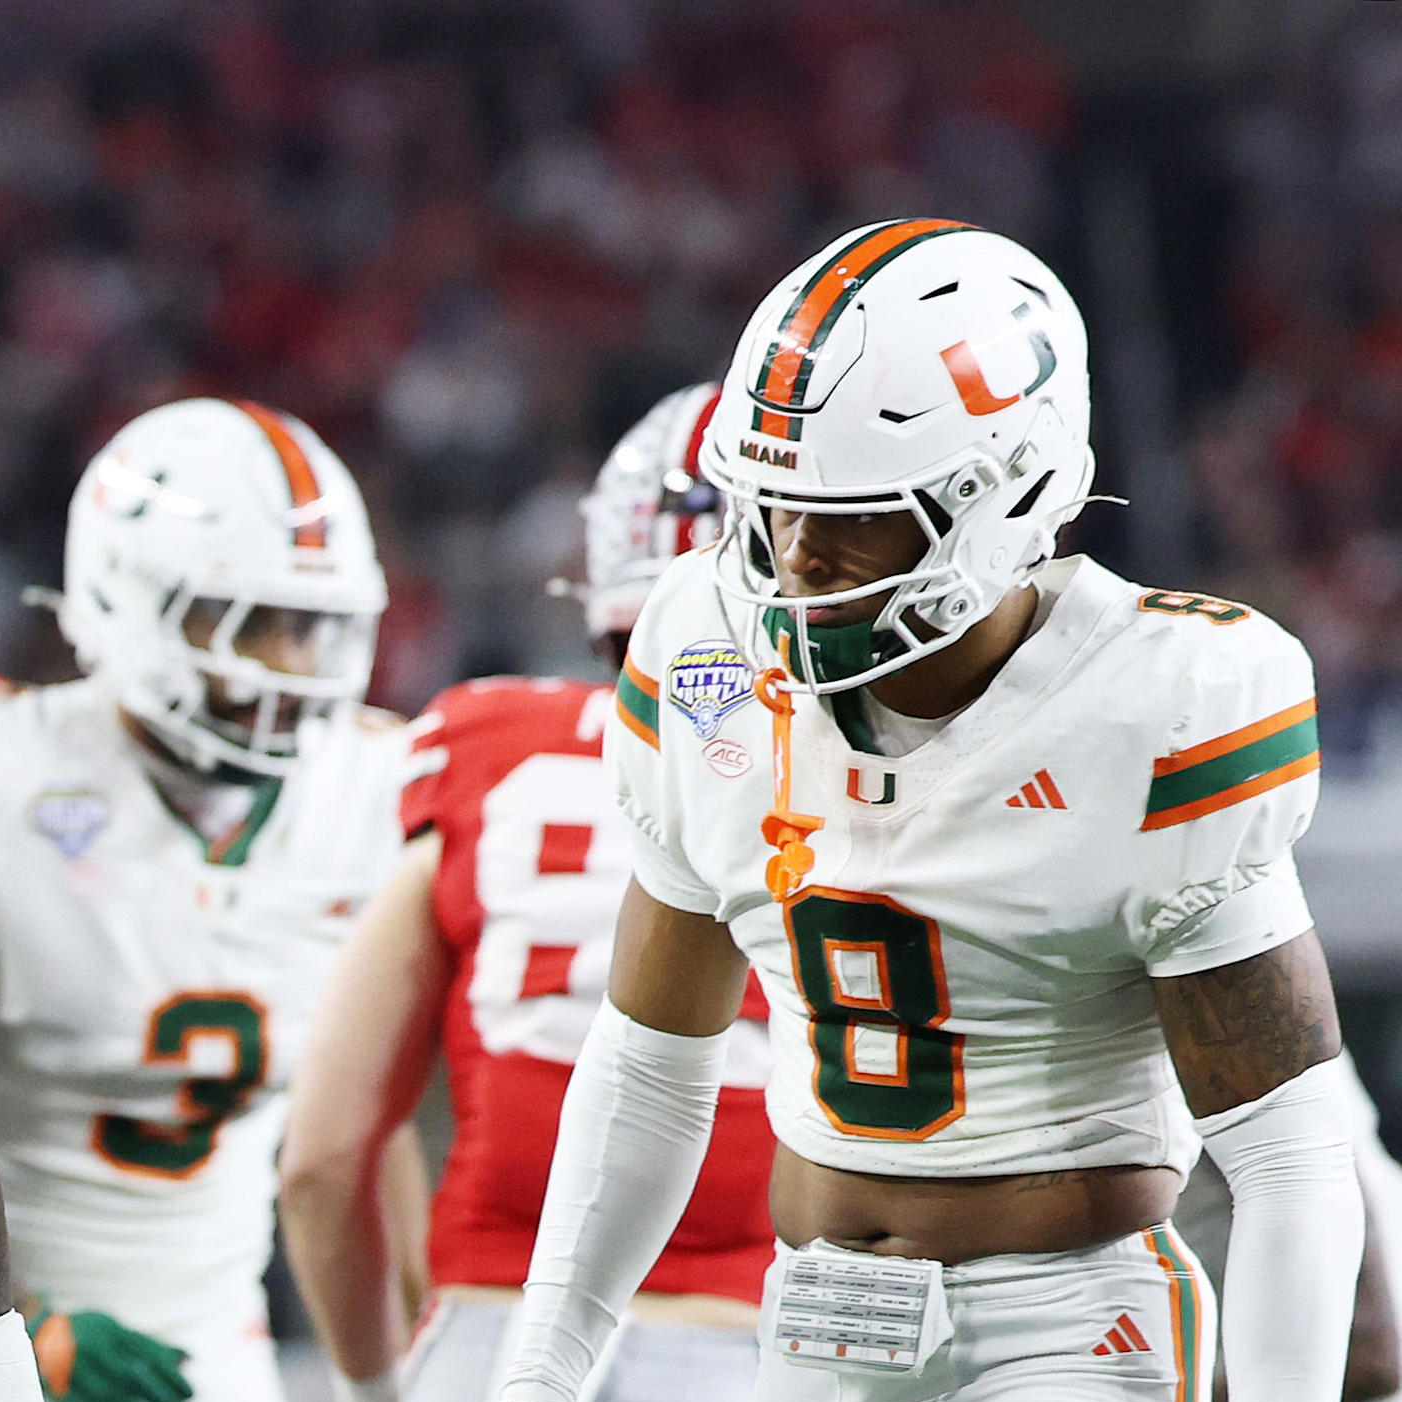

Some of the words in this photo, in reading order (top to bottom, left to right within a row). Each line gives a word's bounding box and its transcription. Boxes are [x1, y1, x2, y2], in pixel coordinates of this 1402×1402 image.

[739, 439, 798, 470] MIAMI
[673, 650, 747, 667] GOODYEA
[671, 667, 754, 700] COTTON
[683, 684, 736, 705] BOWL
[711, 748, 747, 766] ACC
[847, 767, 896, 805] U
[783, 883, 966, 1142] 8
[91, 988, 271, 1182] 3
